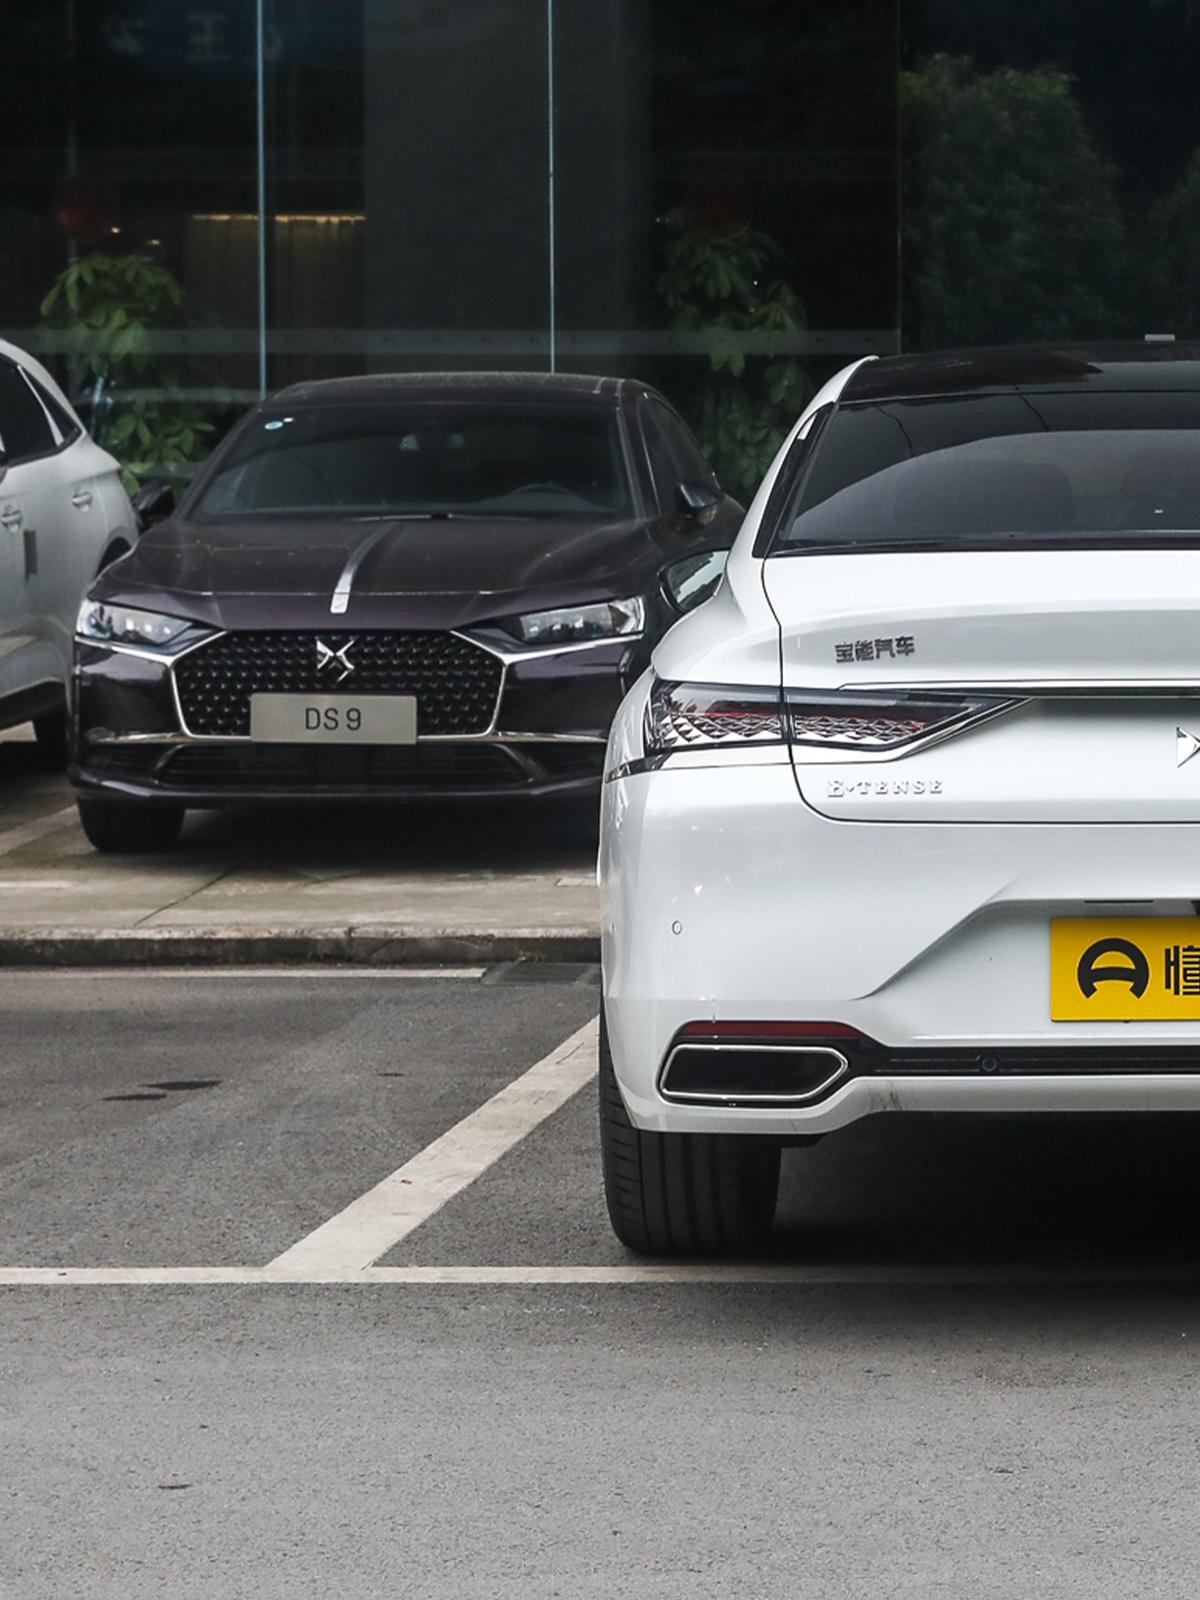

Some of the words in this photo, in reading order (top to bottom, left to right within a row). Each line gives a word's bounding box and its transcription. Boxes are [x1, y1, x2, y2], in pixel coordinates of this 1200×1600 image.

[834, 636, 916, 663] 宝能汽车
[305, 707, 339, 731] DS
[346, 708, 362, 731] 9
